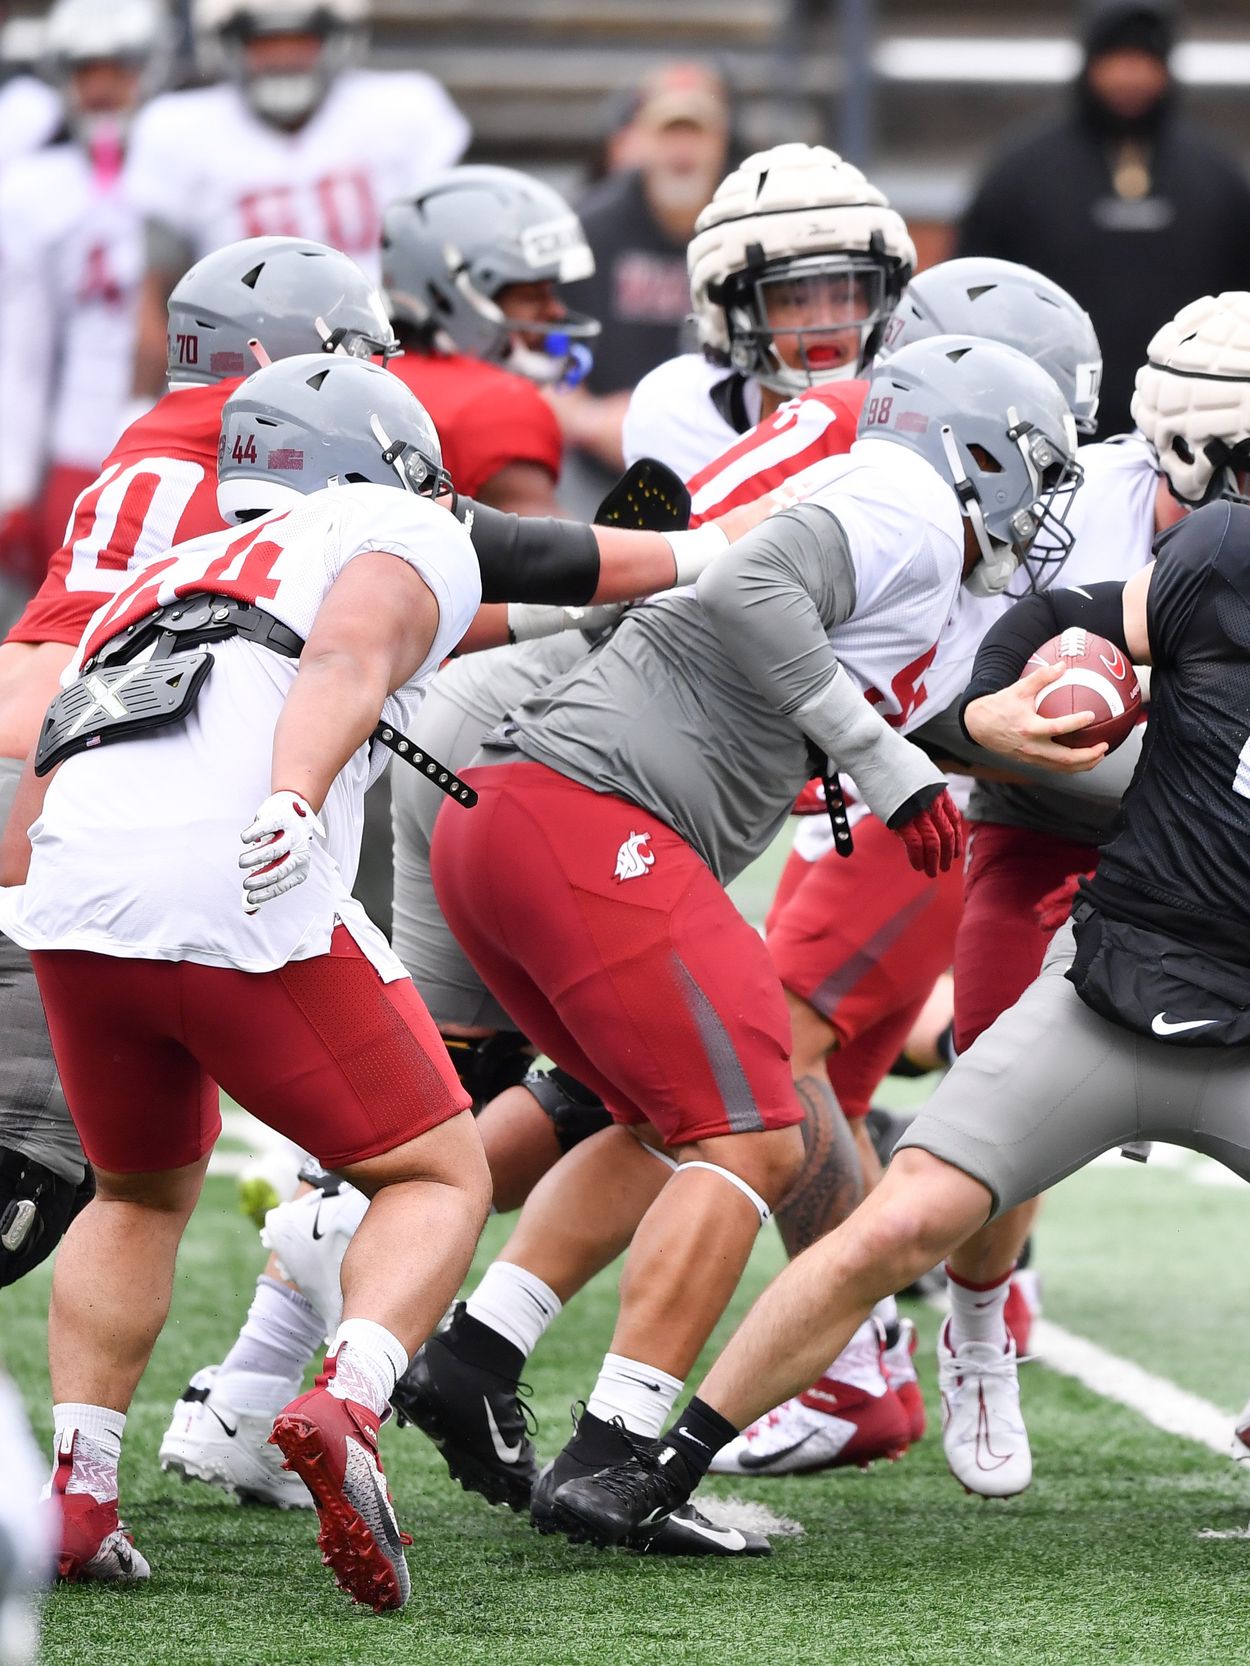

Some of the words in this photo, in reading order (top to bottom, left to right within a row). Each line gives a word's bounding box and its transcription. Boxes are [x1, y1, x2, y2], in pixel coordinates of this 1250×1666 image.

[176, 334, 198, 364] 70
[868, 397, 894, 425] 98
[232, 434, 257, 464] 44
